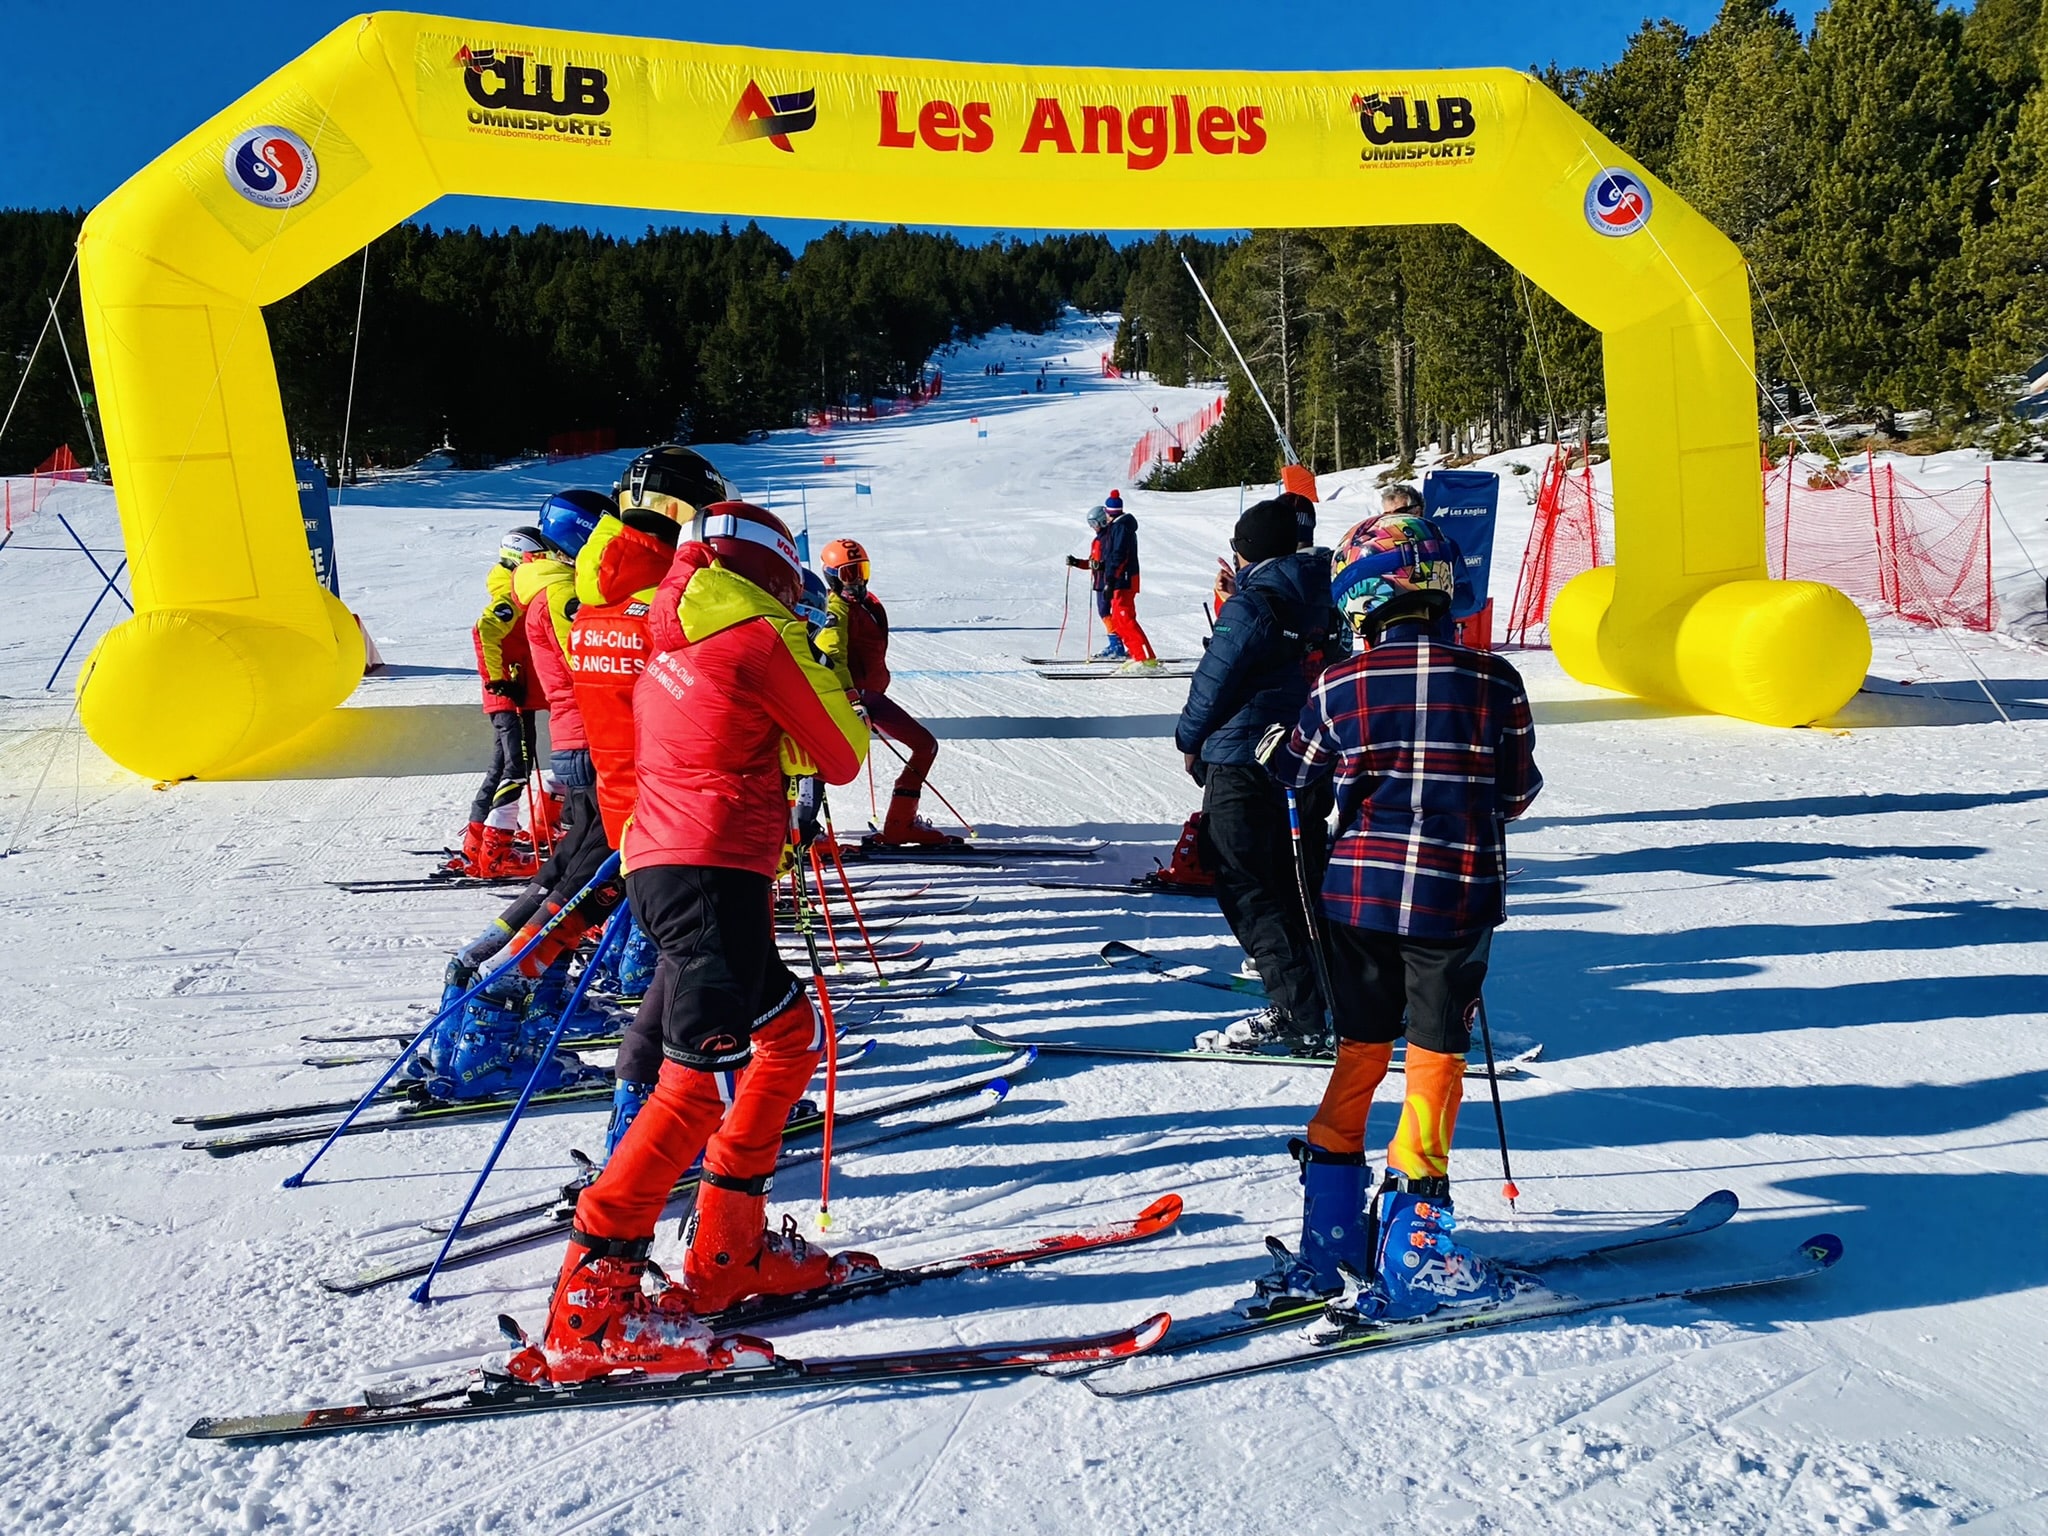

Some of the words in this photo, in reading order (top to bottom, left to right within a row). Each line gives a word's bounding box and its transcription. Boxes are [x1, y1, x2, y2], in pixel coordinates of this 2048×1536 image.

[463, 55, 611, 117] CLUB
[466, 108, 613, 138] OMNISPORTS
[876, 89, 994, 153] Les
[1019, 94, 1268, 171] Angles
[1360, 95, 1476, 146] CLUB
[467, 125, 613, 147] www.clubomnisports-lesangles.fr
[1360, 142, 1476, 161] OMNISPORTS
[575, 517, 595, 531] VOL
[1449, 508, 1462, 516] Les
[1463, 507, 1488, 517] Angles
[775, 538, 800, 566] VOLA
[583, 629, 644, 650] Ski-Club
[582, 655, 645, 675] ANGLES
[666, 656, 695, 687] Ski-Club
[647, 661, 658, 676] LES
[656, 670, 685, 701] ANGLES
[799, 896, 813, 935] LEKI
